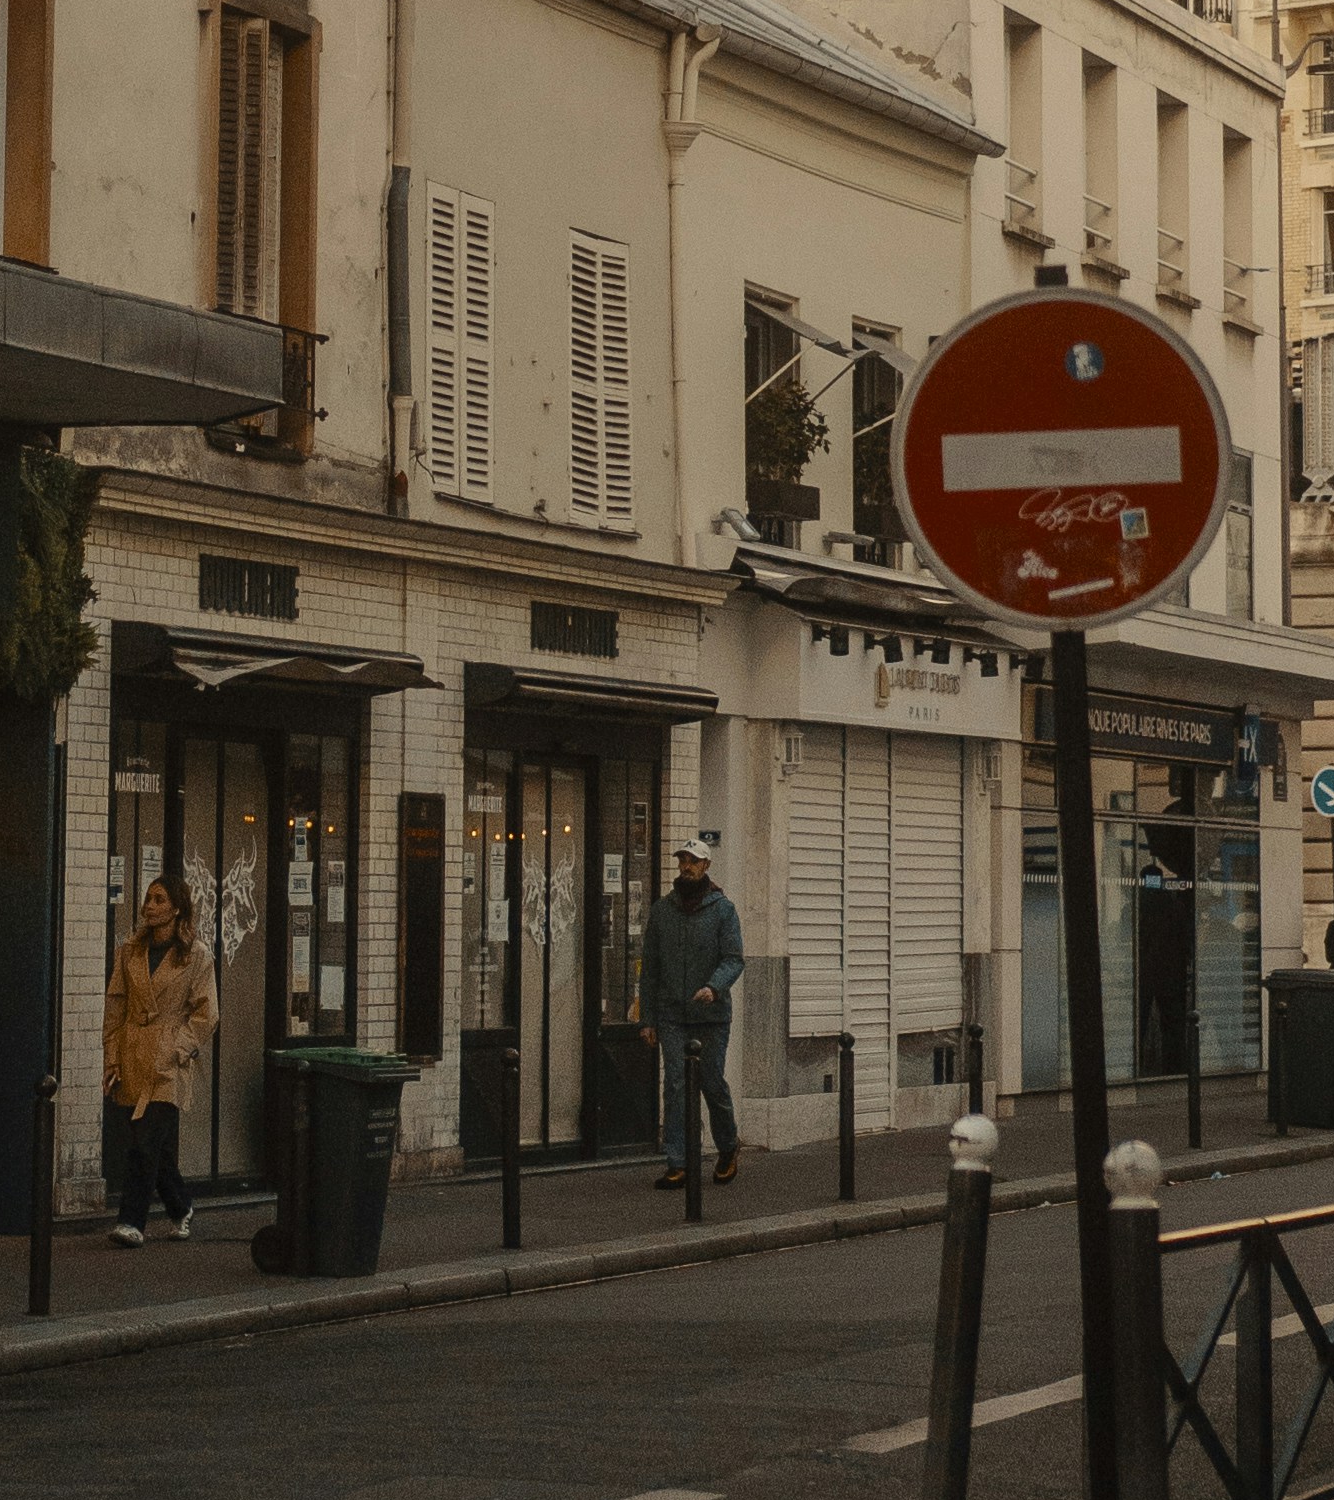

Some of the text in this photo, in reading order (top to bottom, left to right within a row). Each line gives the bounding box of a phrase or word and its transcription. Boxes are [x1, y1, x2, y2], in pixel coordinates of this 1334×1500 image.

[908, 705, 940, 721] PARIS
[1110, 711, 1156, 738] POPULAIRE
[1179, 720, 1190, 743] DE
[1190, 722, 1212, 746] PARIS
[114, 771, 160, 794] MARGUERITE
